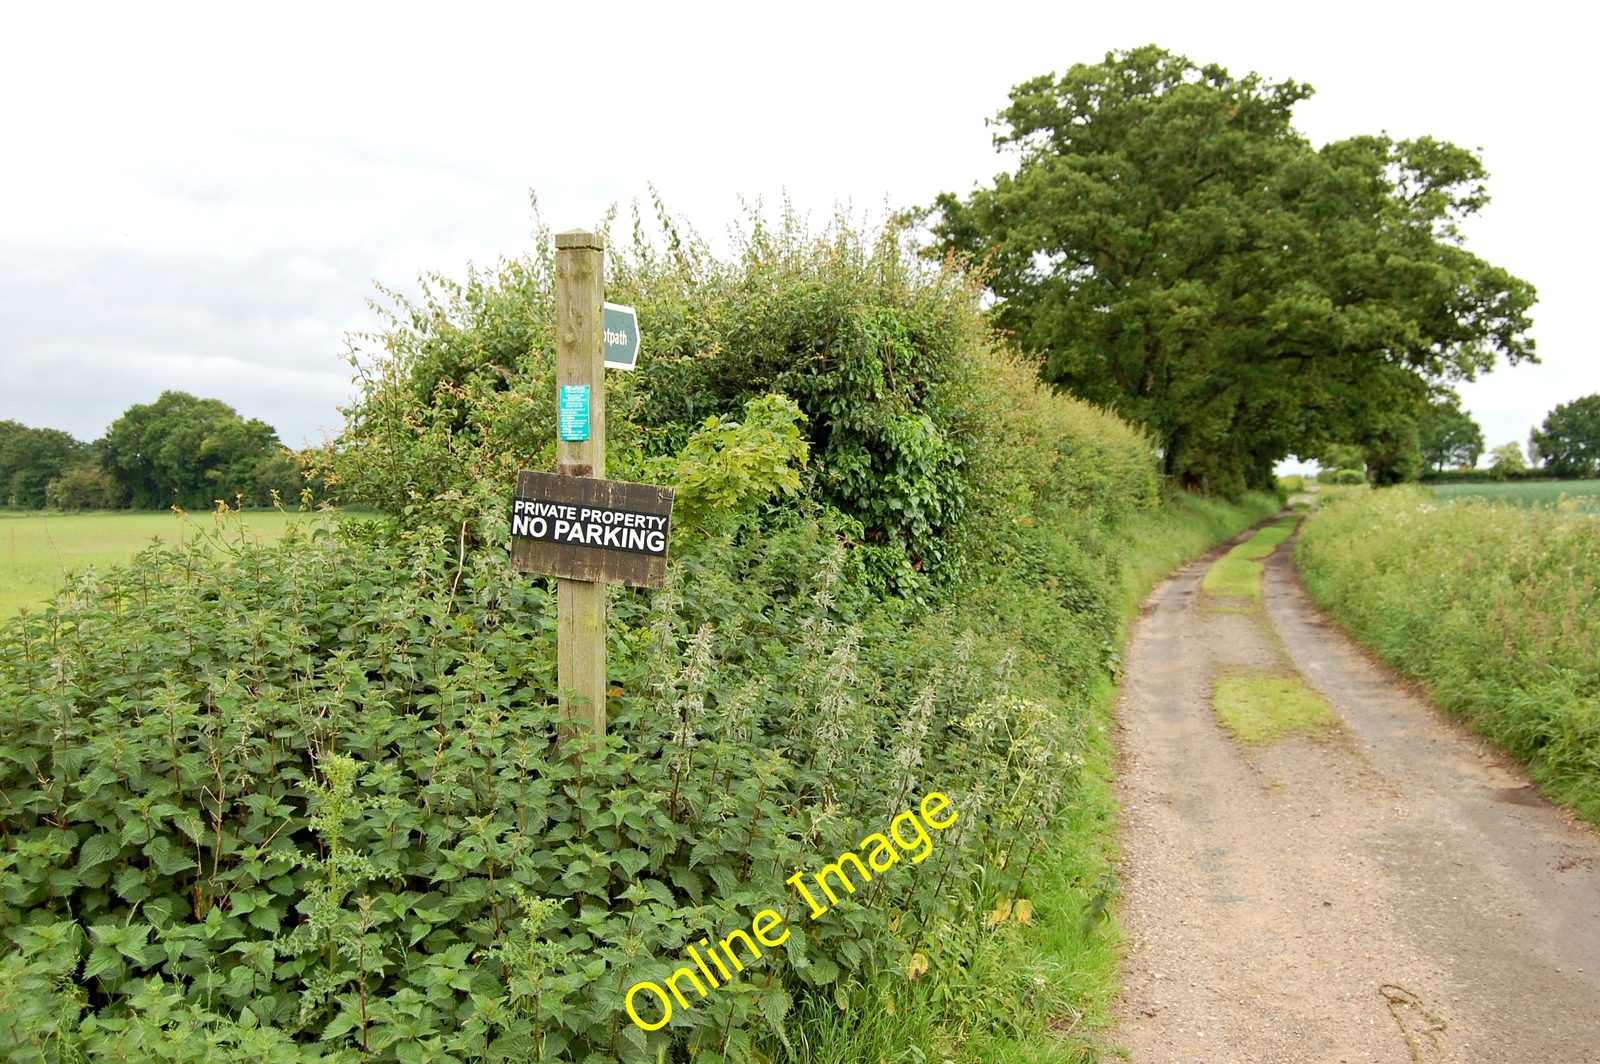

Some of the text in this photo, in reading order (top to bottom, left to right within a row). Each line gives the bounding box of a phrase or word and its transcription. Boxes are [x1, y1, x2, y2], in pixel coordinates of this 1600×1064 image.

[514, 500, 667, 530] PRIVATE PROPERTY
[512, 514, 665, 552] NO PARKING
